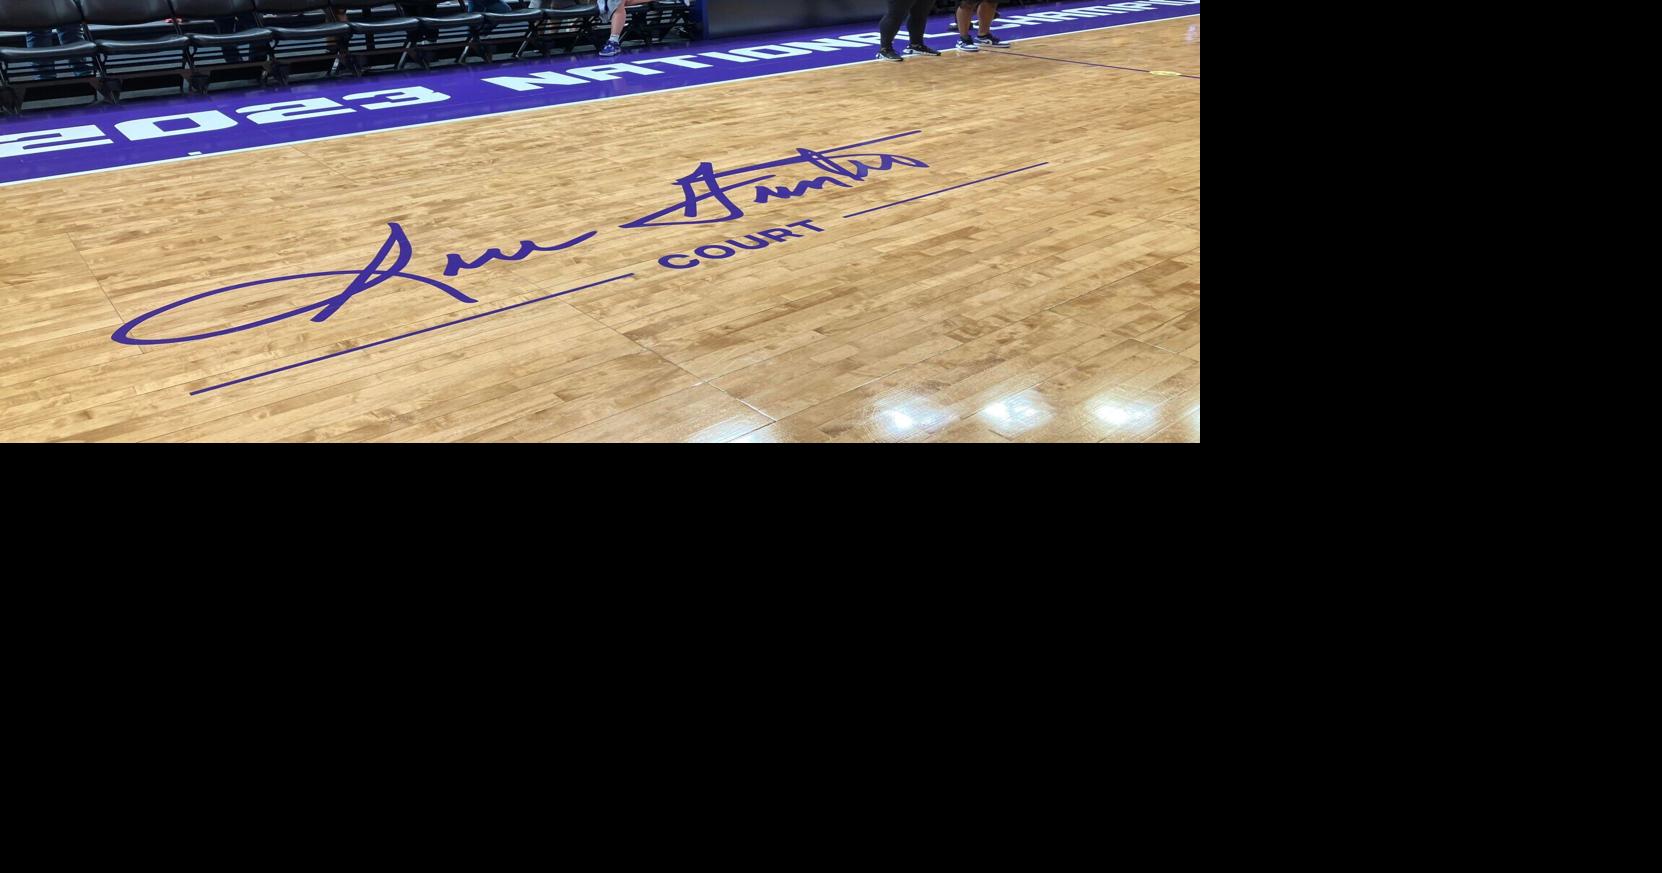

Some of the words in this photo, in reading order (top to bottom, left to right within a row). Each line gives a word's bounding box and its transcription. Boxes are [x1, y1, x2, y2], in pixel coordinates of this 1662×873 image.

[0, 85, 451, 158] 2023
[481, 30, 961, 92] NATIONAL
[657, 218, 825, 270] COURT
